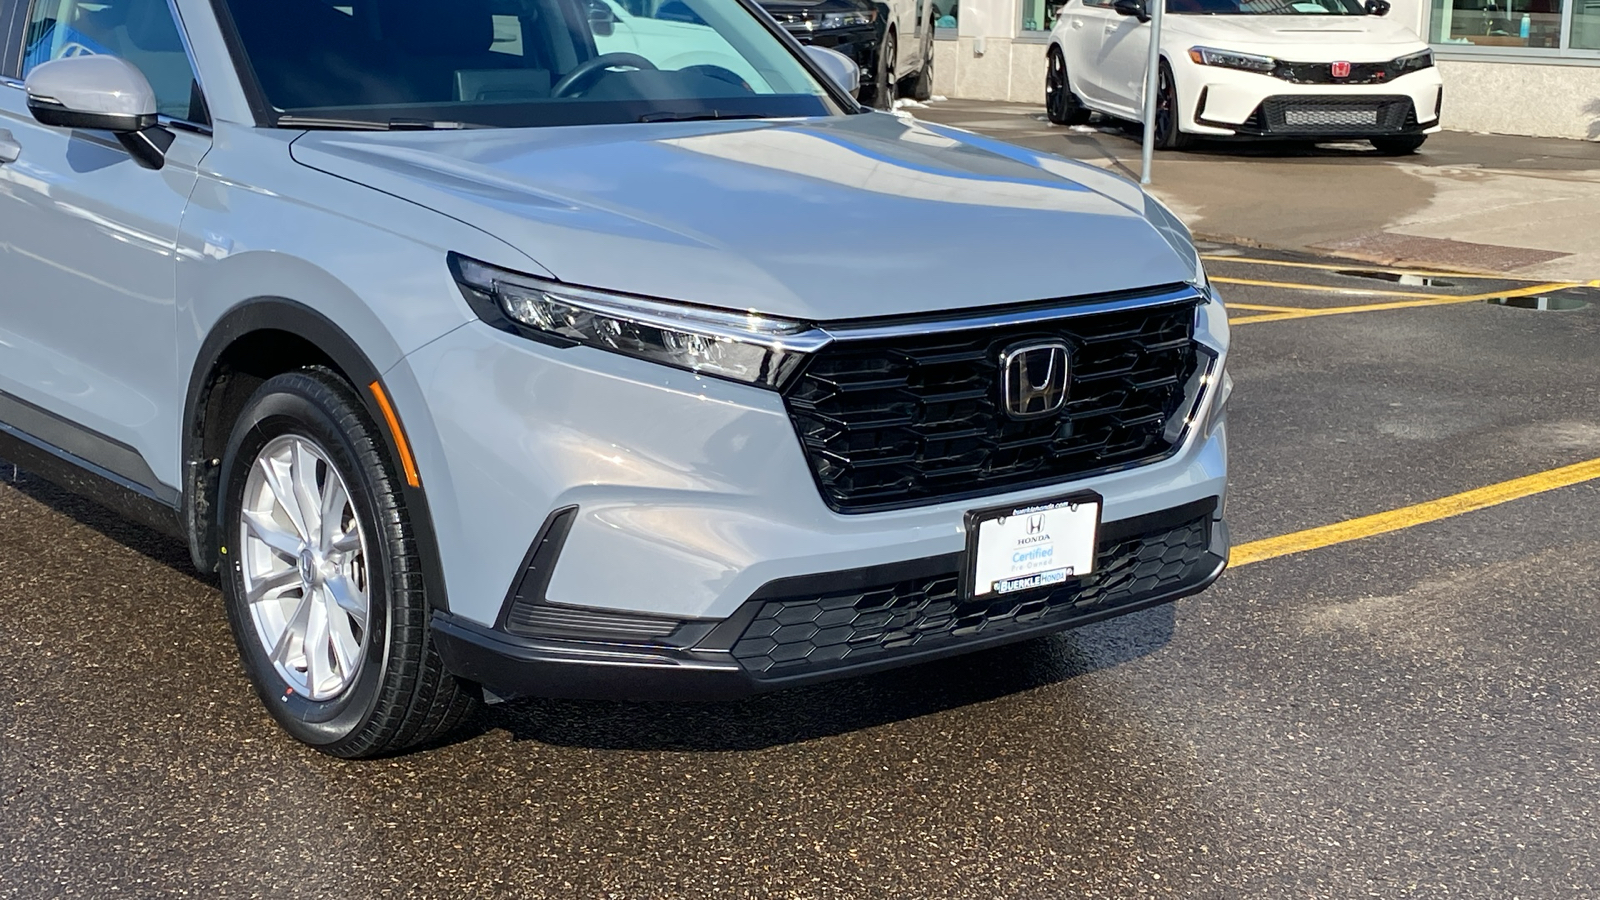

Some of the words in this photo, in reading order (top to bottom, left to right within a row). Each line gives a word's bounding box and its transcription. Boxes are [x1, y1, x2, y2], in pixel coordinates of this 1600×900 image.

[1012, 501, 1069, 516] buerklehonda.com
[1017, 534, 1051, 545] HONDA
[1012, 545, 1054, 563] Certified
[1000, 576, 1041, 592] BUERKLE
[1041, 572, 1065, 584] HONDA
